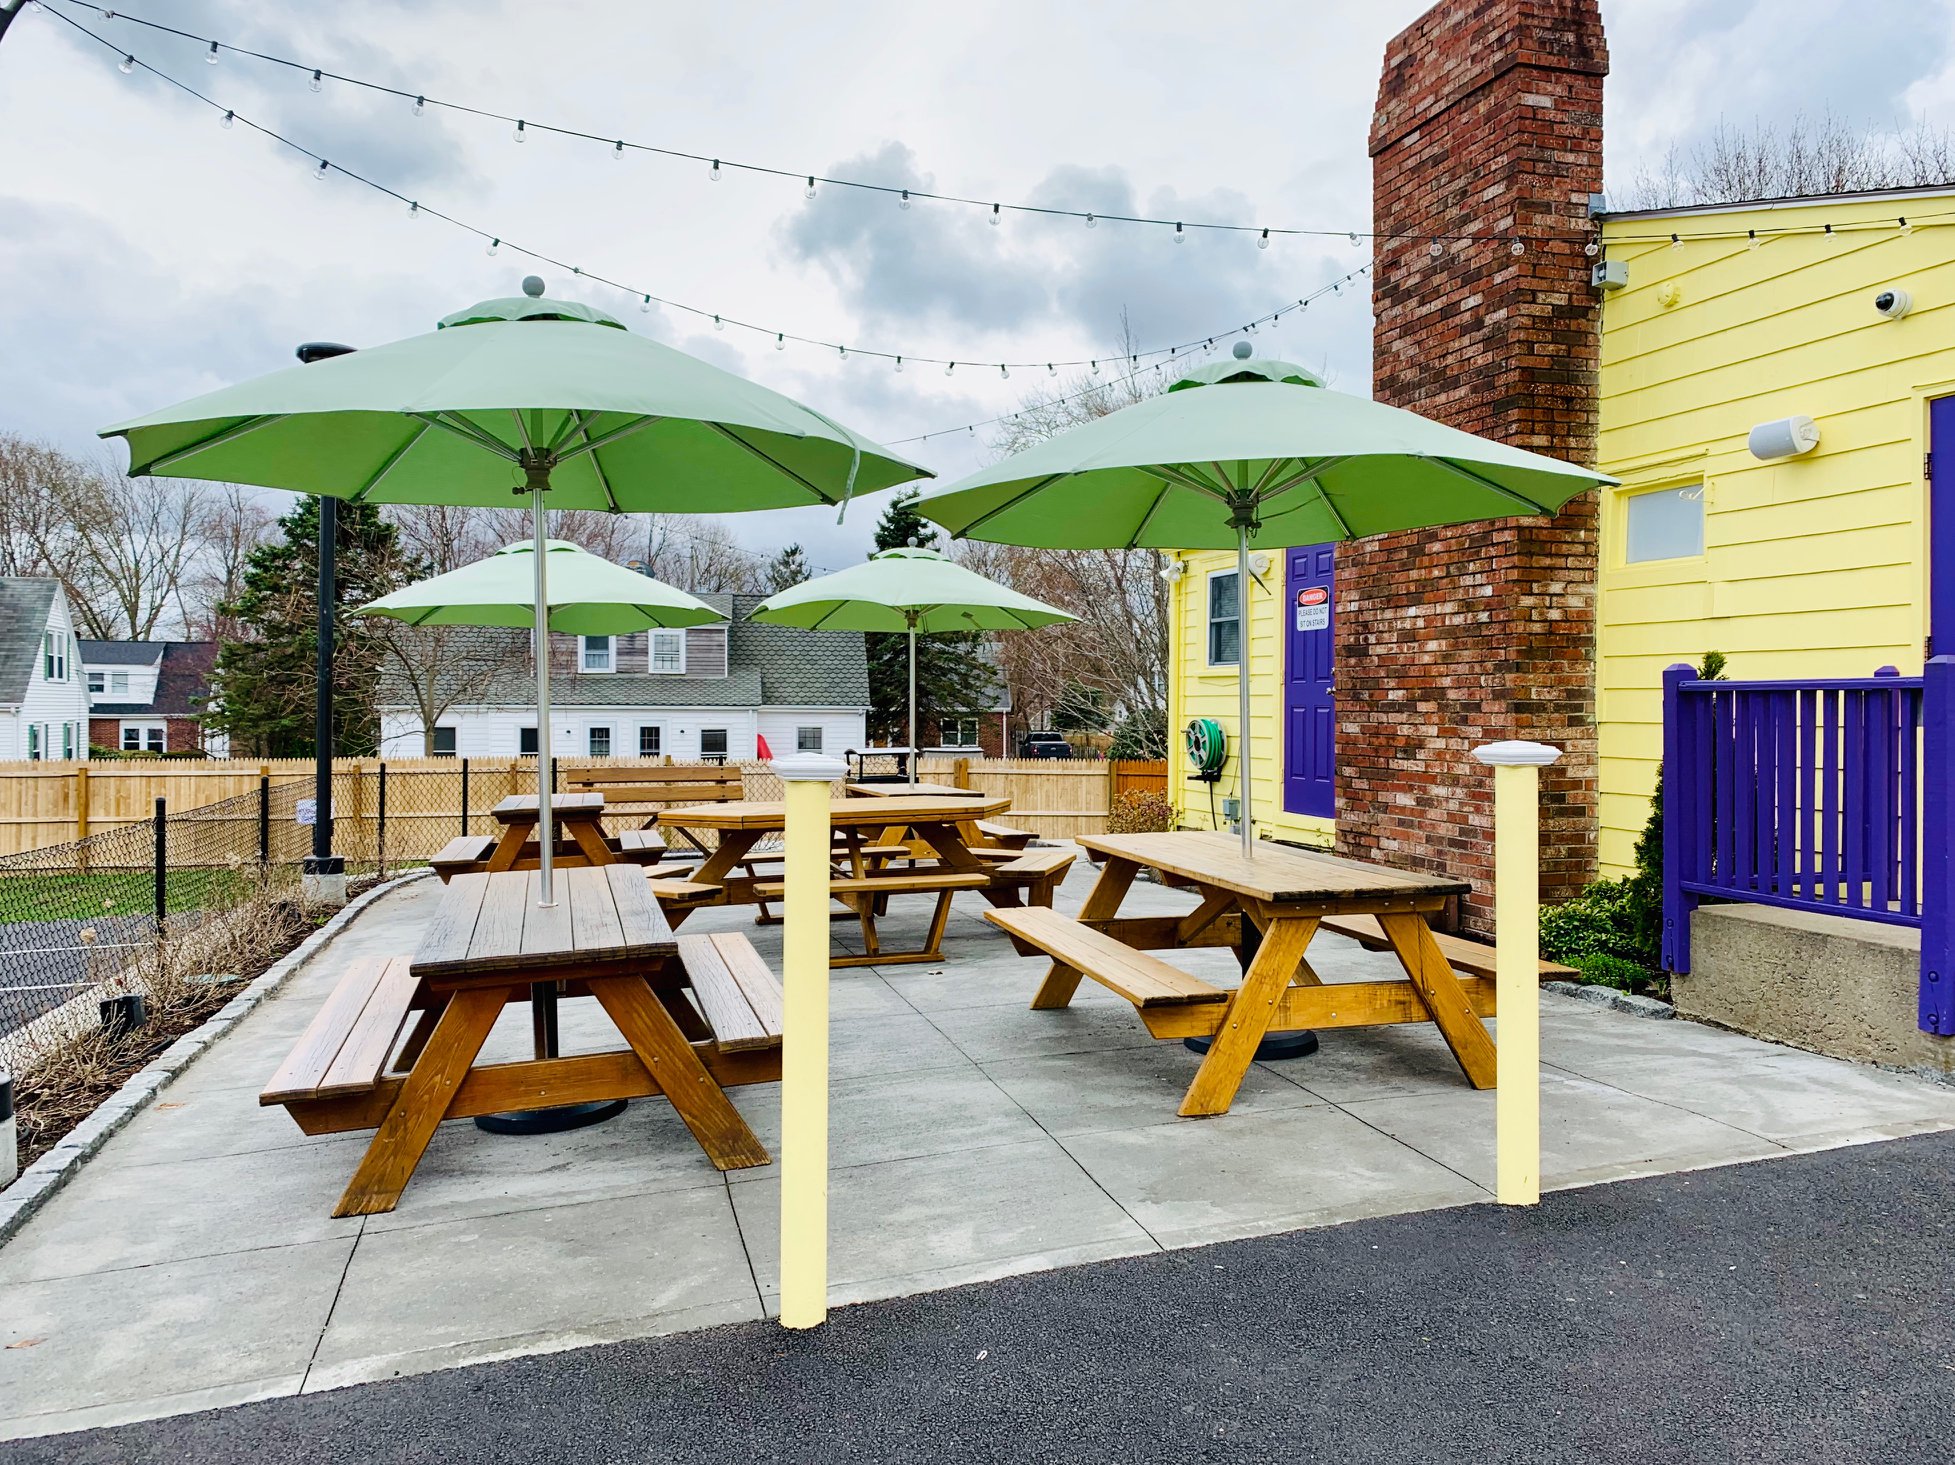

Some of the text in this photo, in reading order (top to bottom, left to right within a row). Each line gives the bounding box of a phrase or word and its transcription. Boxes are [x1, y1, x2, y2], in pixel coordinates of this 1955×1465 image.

[1303, 592, 1323, 601] DANGER
[1298, 608, 1312, 616] PLEASE
[1319, 606, 1327, 614] NOT
[1312, 618, 1325, 627] STAIRS
